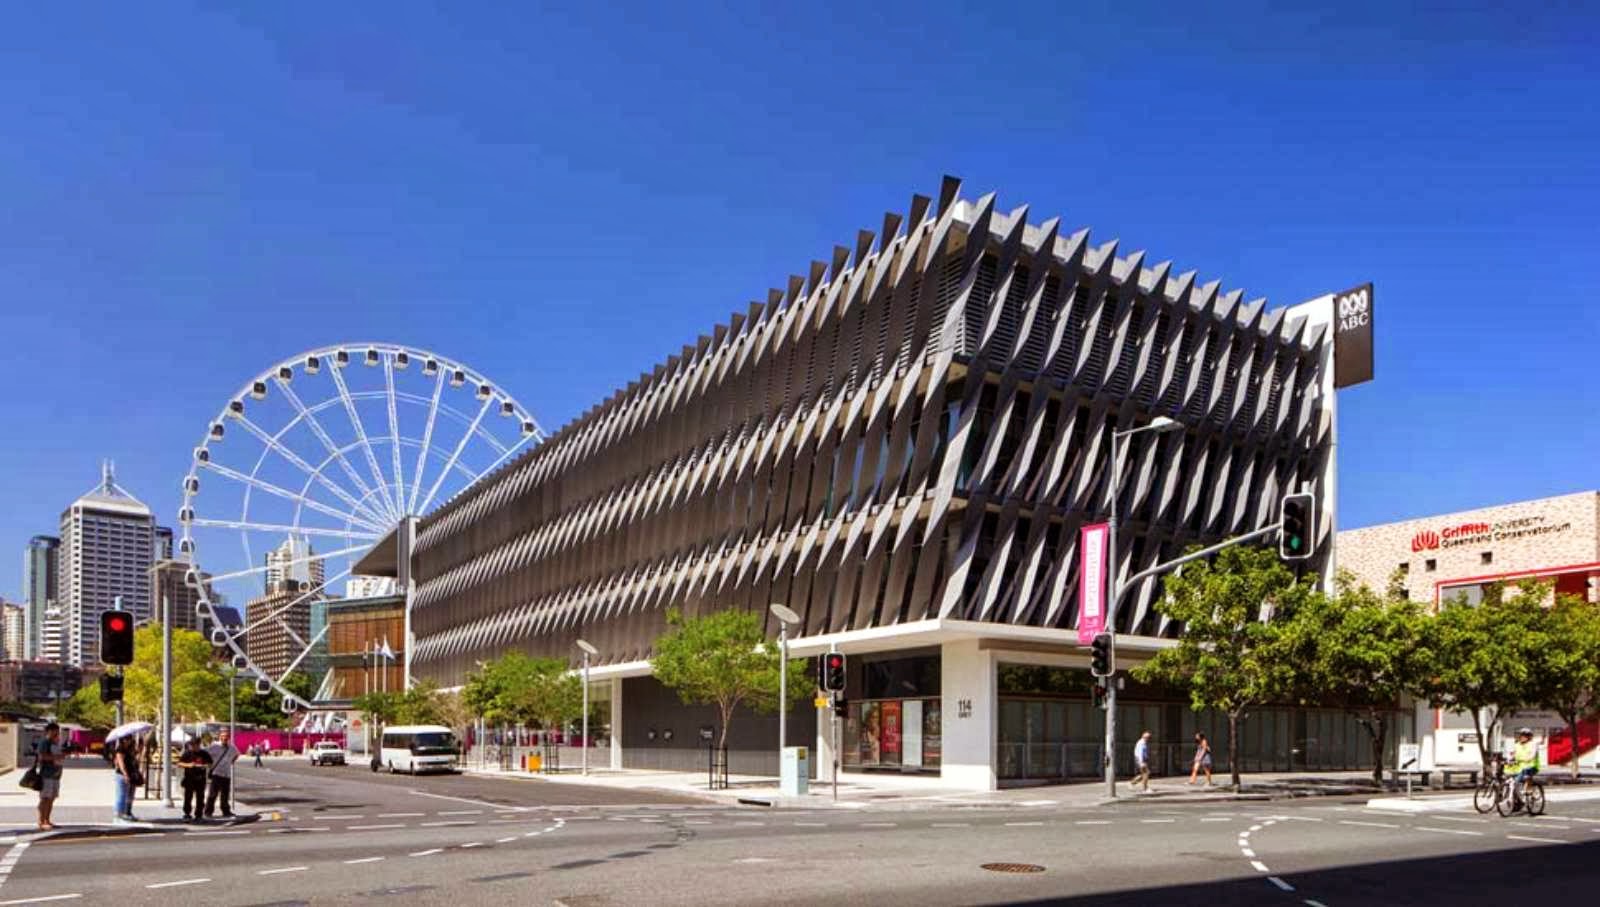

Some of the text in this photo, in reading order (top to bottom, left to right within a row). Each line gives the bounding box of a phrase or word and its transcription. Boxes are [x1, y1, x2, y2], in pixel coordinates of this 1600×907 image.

[1339, 312, 1369, 333] ABC
[1441, 522, 1570, 549] Queensland Conservatorium
[1442, 522, 1490, 538] Griffith
[958, 699, 972, 712] 114
